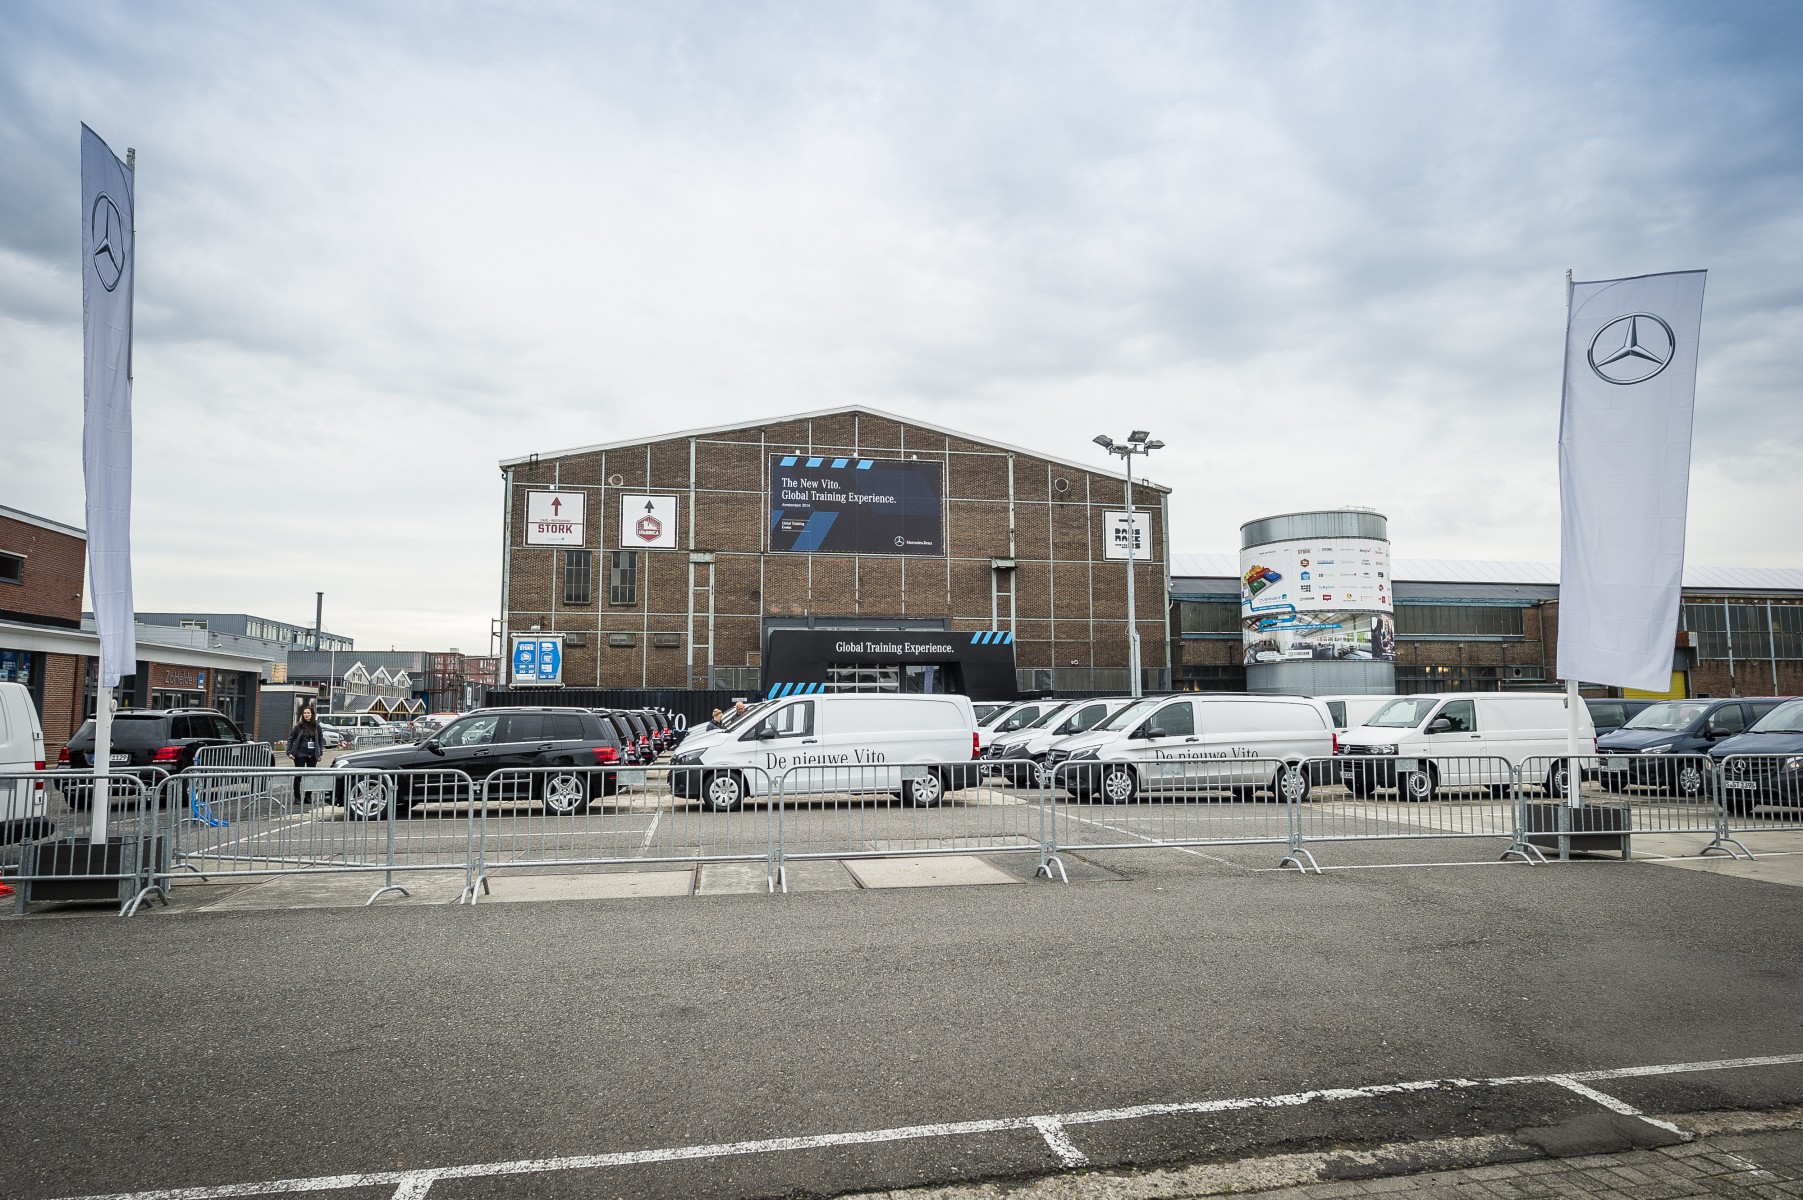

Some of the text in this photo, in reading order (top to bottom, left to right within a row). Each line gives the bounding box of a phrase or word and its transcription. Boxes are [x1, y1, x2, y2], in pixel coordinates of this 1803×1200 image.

[782, 478, 841, 490] The New Vito.
[782, 490, 896, 504] Global Training Experience.
[538, 524, 572, 534] STORK
[836, 642, 954, 655] Global Training Experience.
[766, 752, 787, 770] De
[792, 752, 848, 765] nieuwe
[1178, 749, 1227, 764] nieuwe
